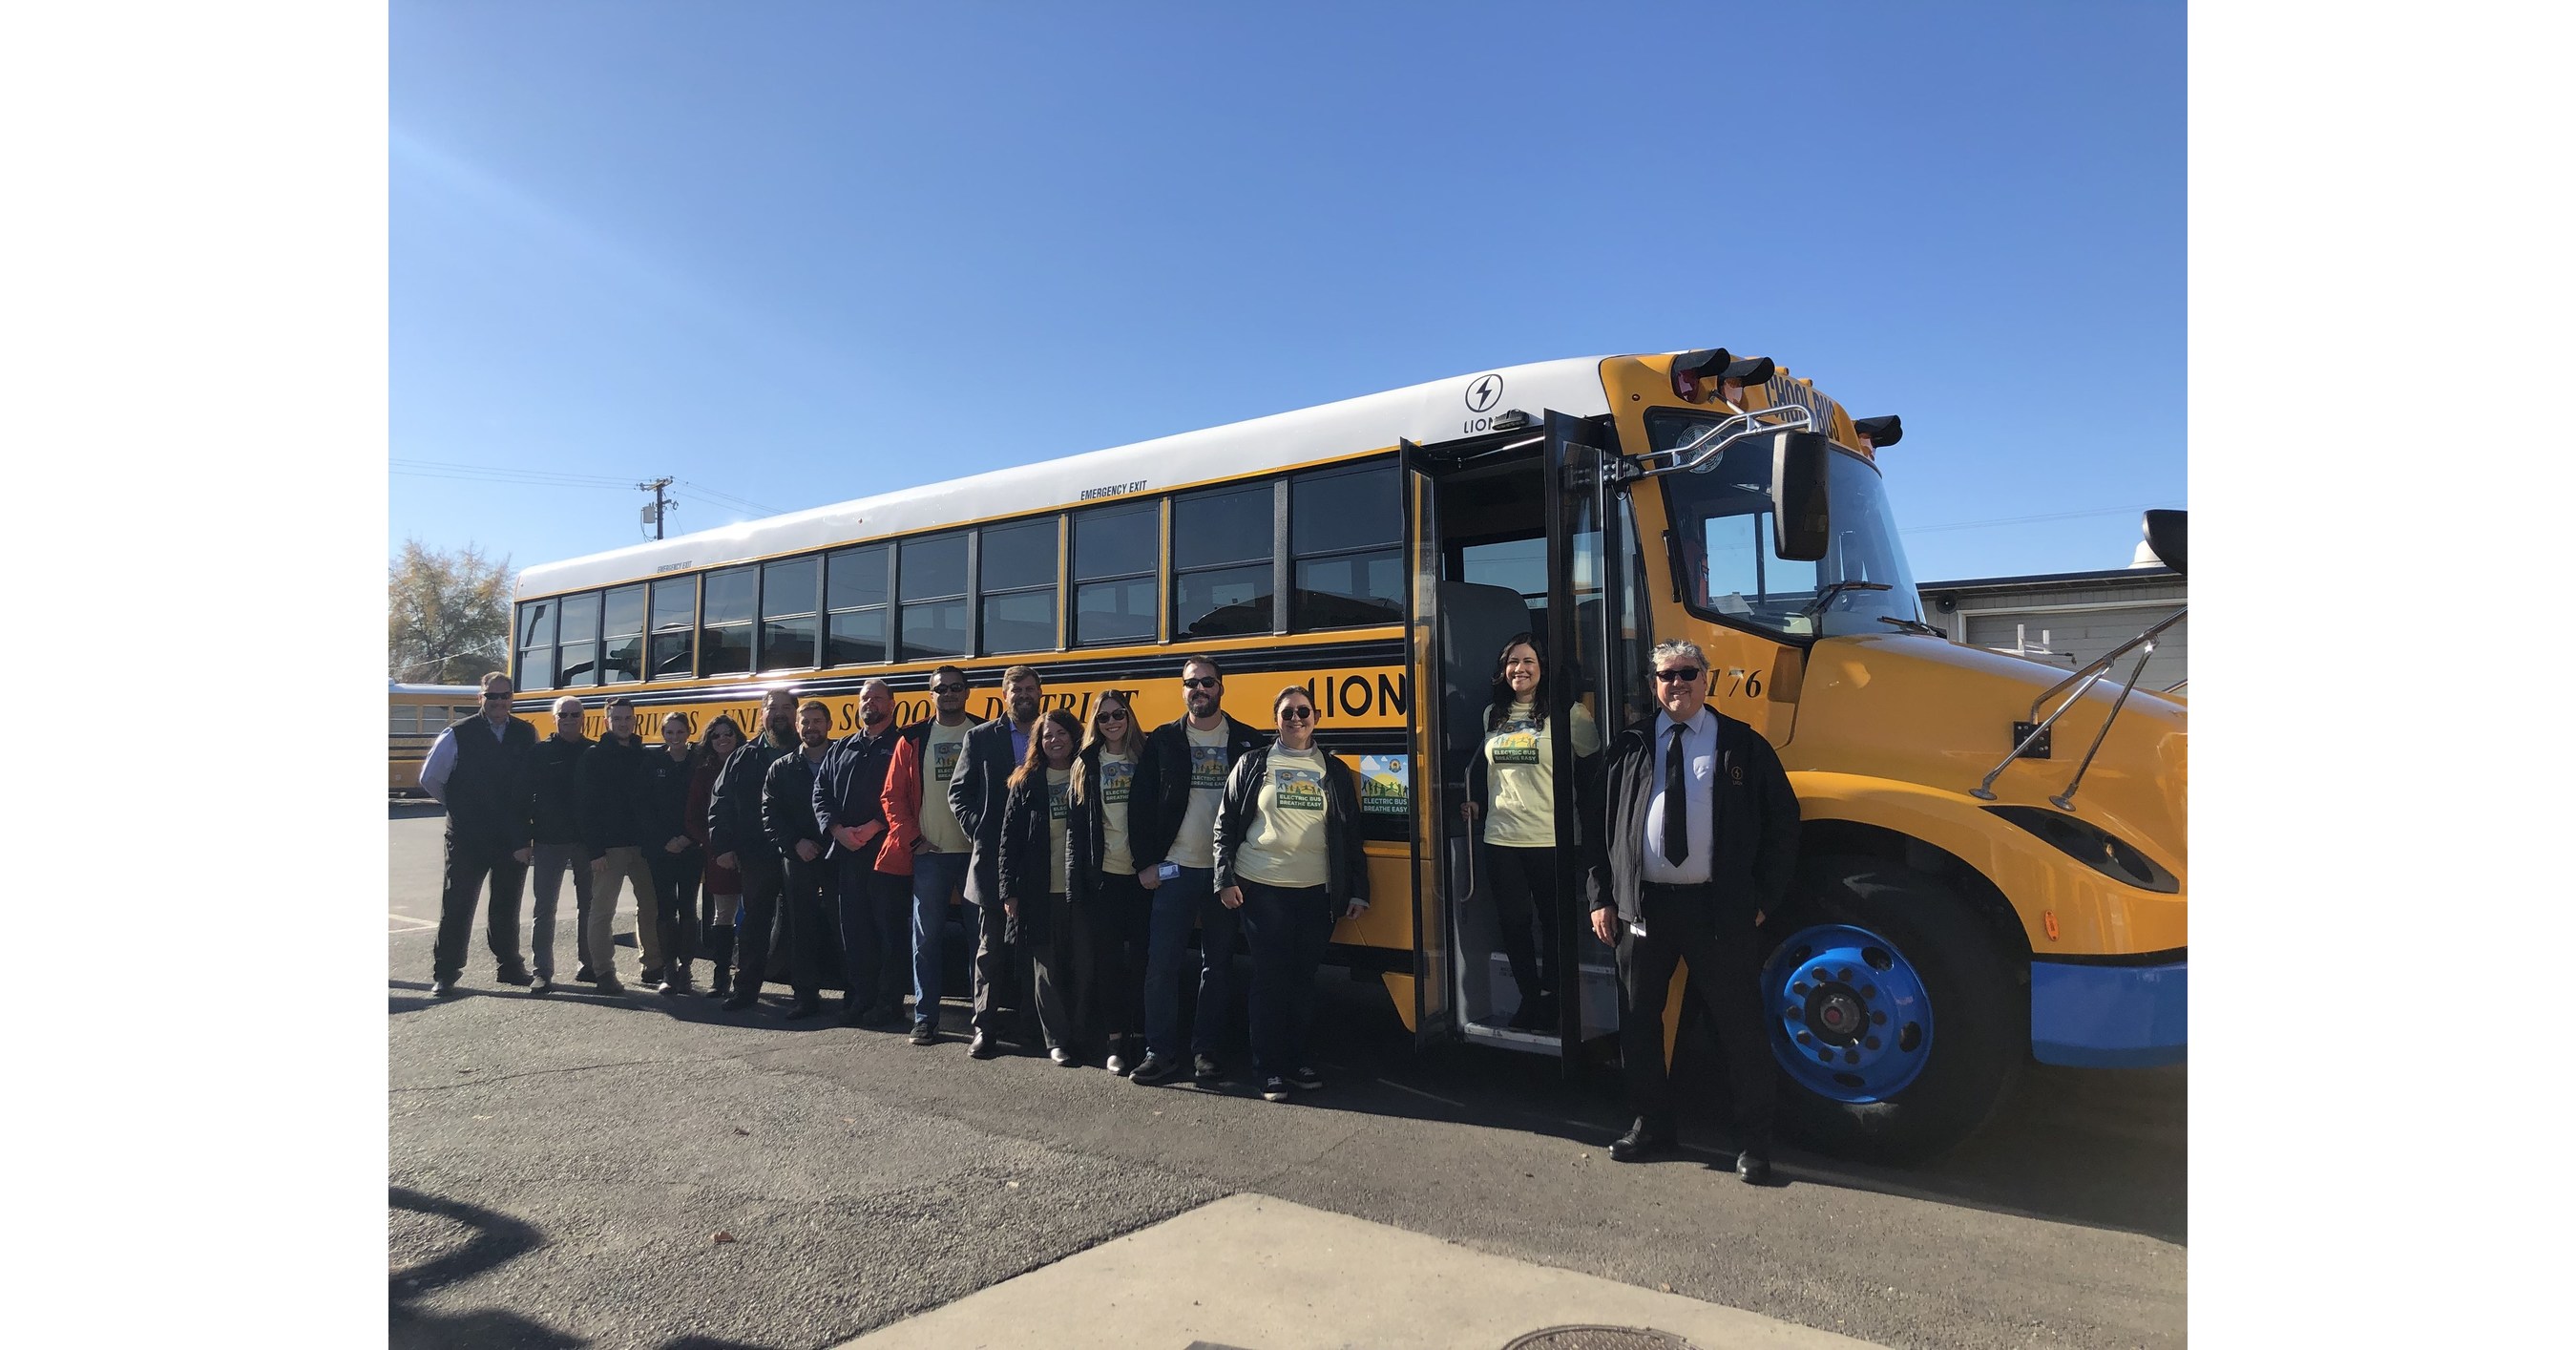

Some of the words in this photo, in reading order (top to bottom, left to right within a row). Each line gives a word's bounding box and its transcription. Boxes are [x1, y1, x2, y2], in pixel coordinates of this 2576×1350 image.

[1812, 390, 1840, 442] BUS
[1080, 483, 1128, 501] EMERGENCY
[1129, 479, 1148, 493] EXIT
[1308, 672, 1408, 718] LION
[1705, 668, 1763, 699] 176
[633, 710, 701, 736] RIVS
[985, 689, 1140, 724] DTRIT
